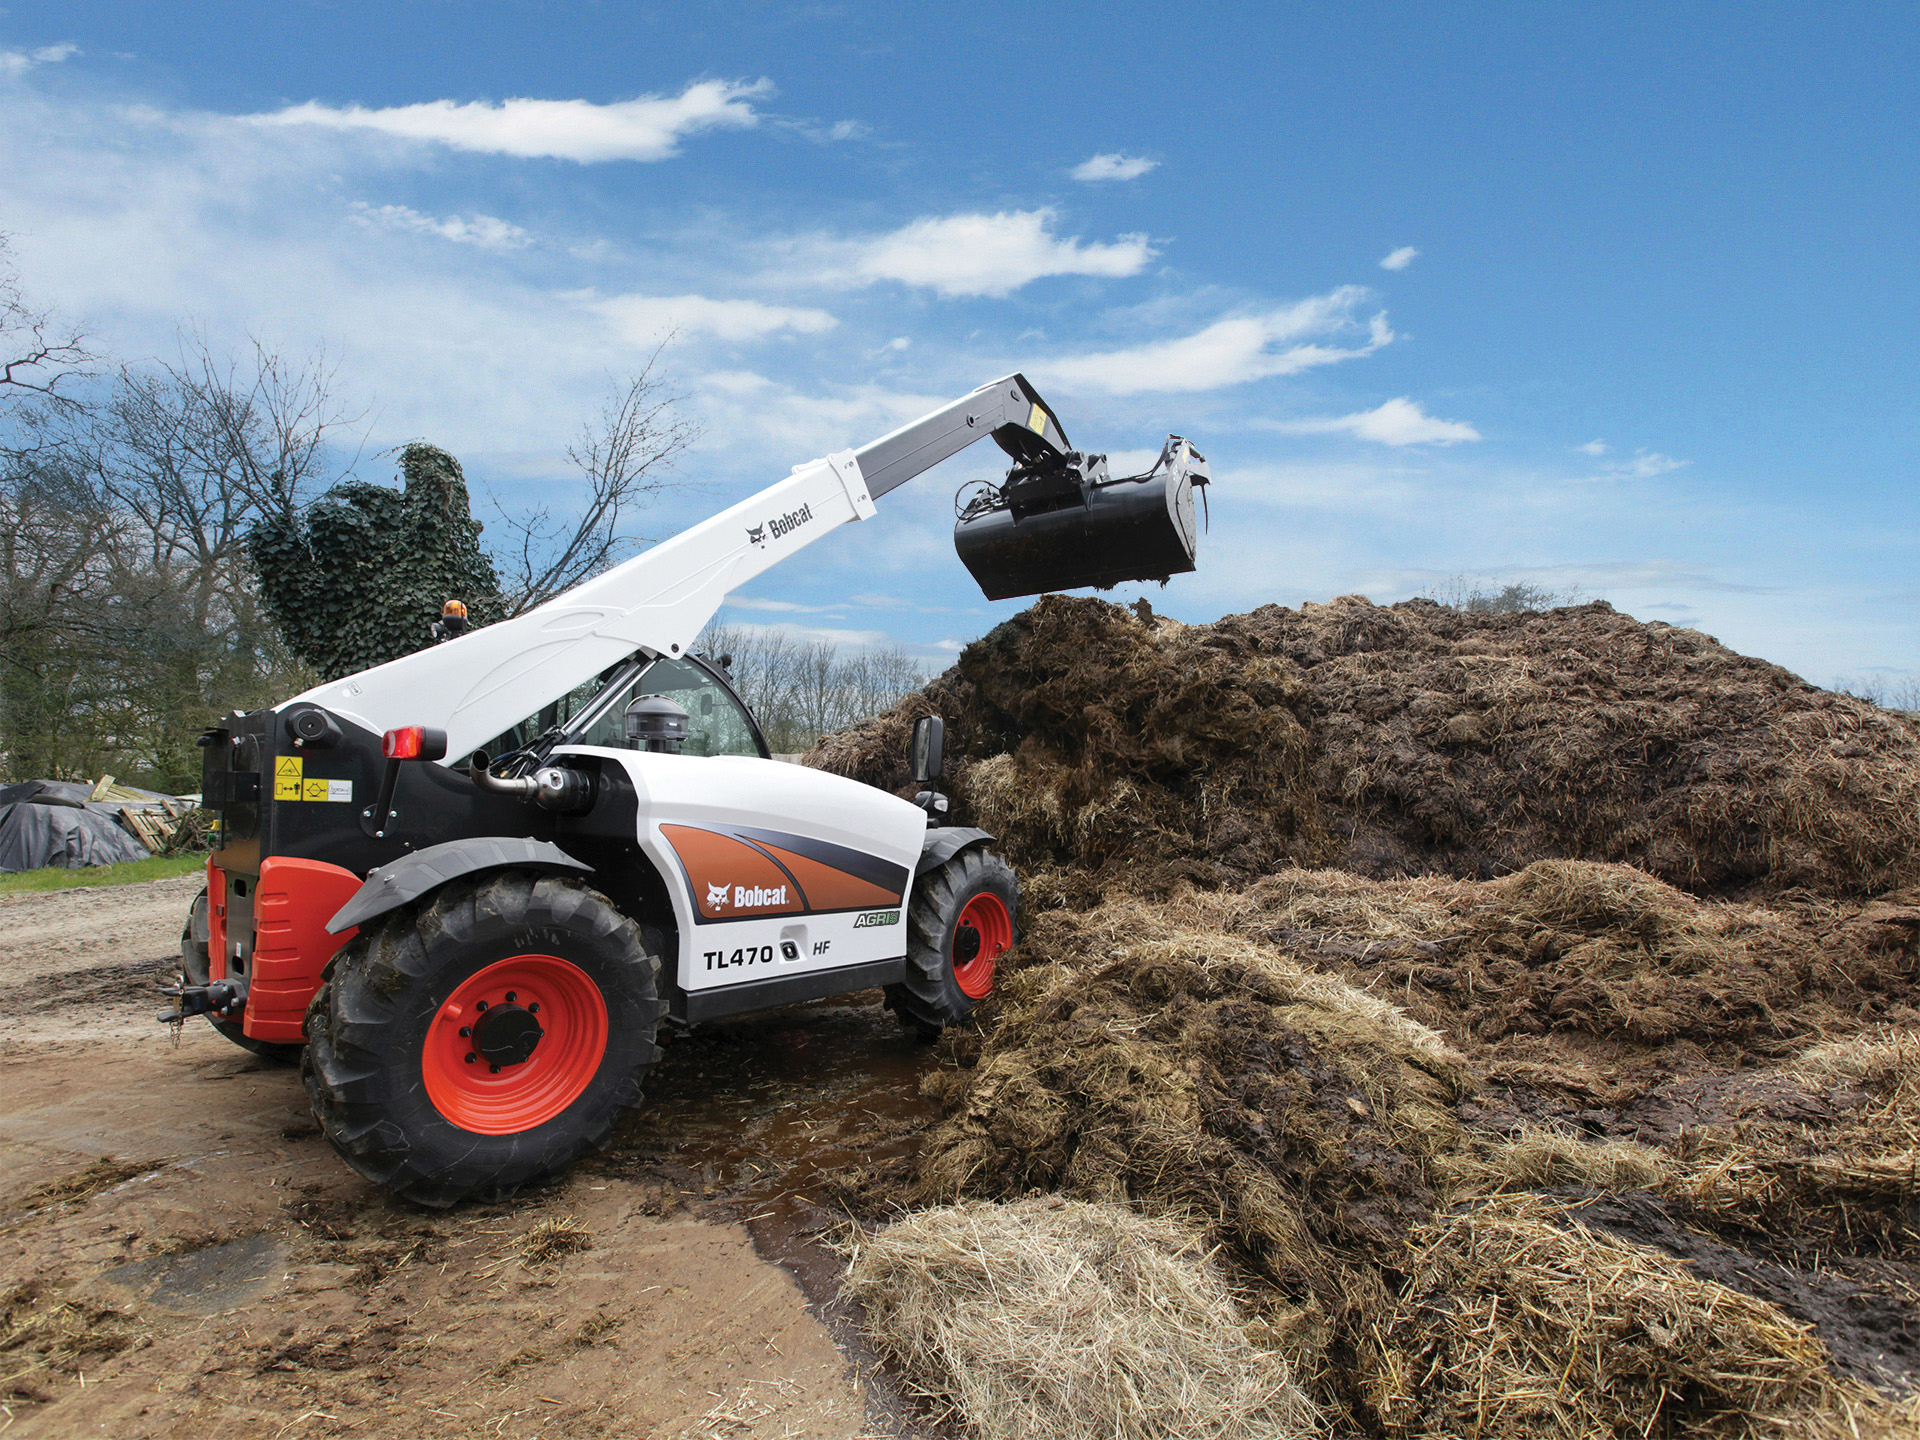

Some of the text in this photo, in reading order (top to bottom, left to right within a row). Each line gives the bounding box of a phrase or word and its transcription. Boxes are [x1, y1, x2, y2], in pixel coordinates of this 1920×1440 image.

[767, 502, 813, 540] Bobcat
[734, 884, 787, 908] Bobcat
[855, 911, 890, 927] AGRI
[703, 940, 831, 970] TL470 HF
